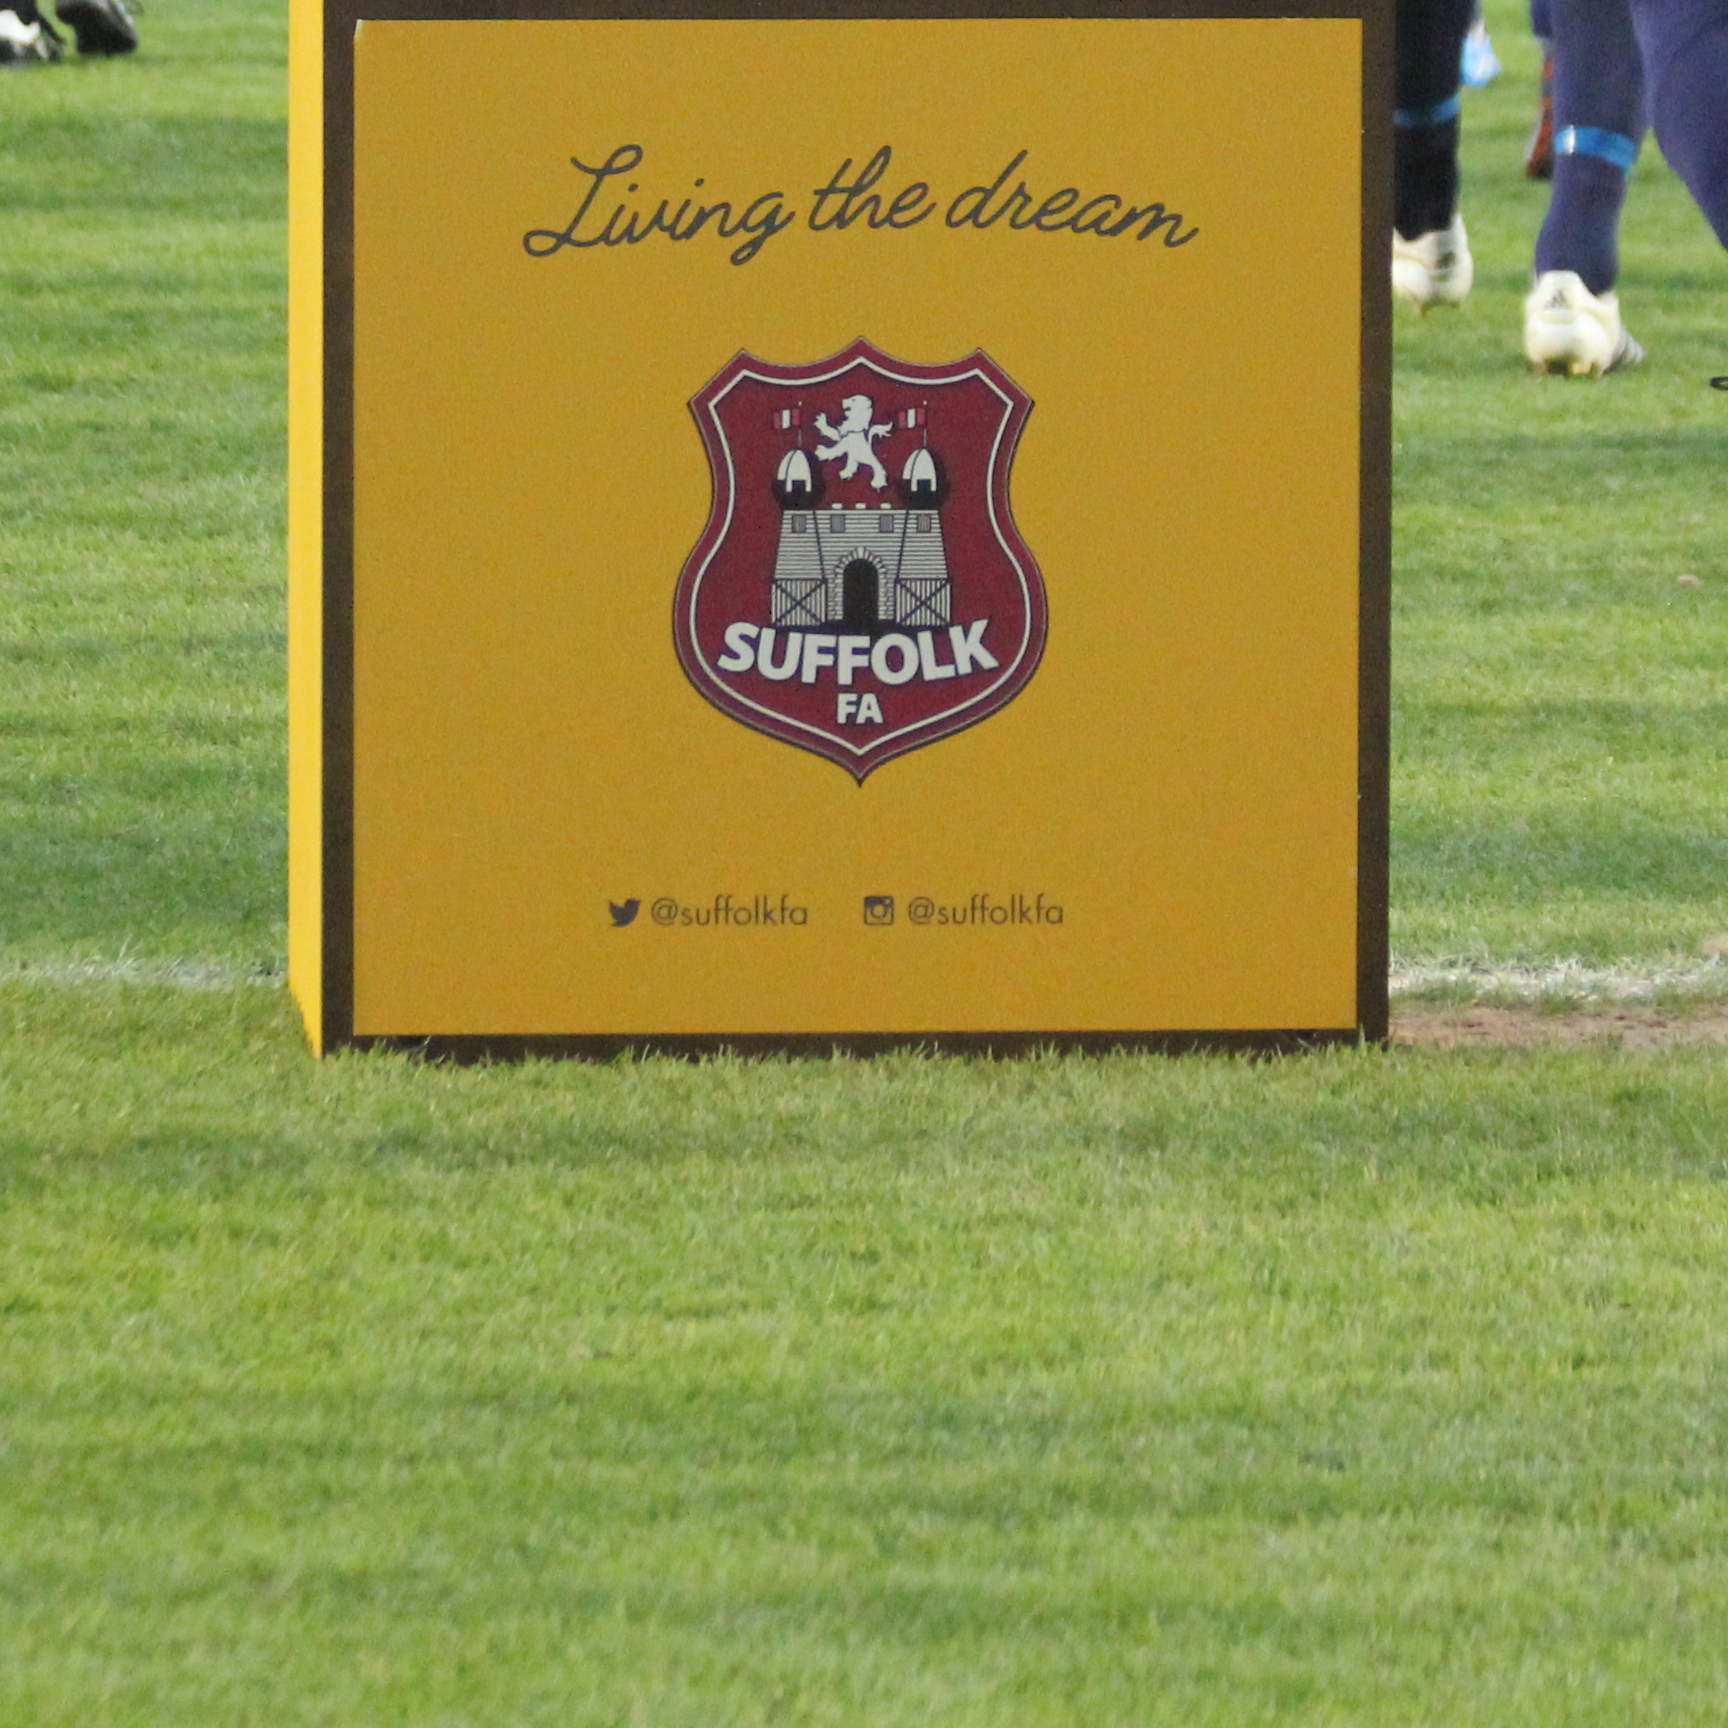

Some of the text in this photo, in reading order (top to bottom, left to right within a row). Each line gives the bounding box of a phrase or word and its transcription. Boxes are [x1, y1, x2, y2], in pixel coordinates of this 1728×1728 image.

[522, 143, 1200, 266] Living the dream
[716, 618, 1000, 685] SUFFOLK
[836, 692, 884, 724] FA
[650, 893, 1065, 927] @suffolkfa @suffolkfa
